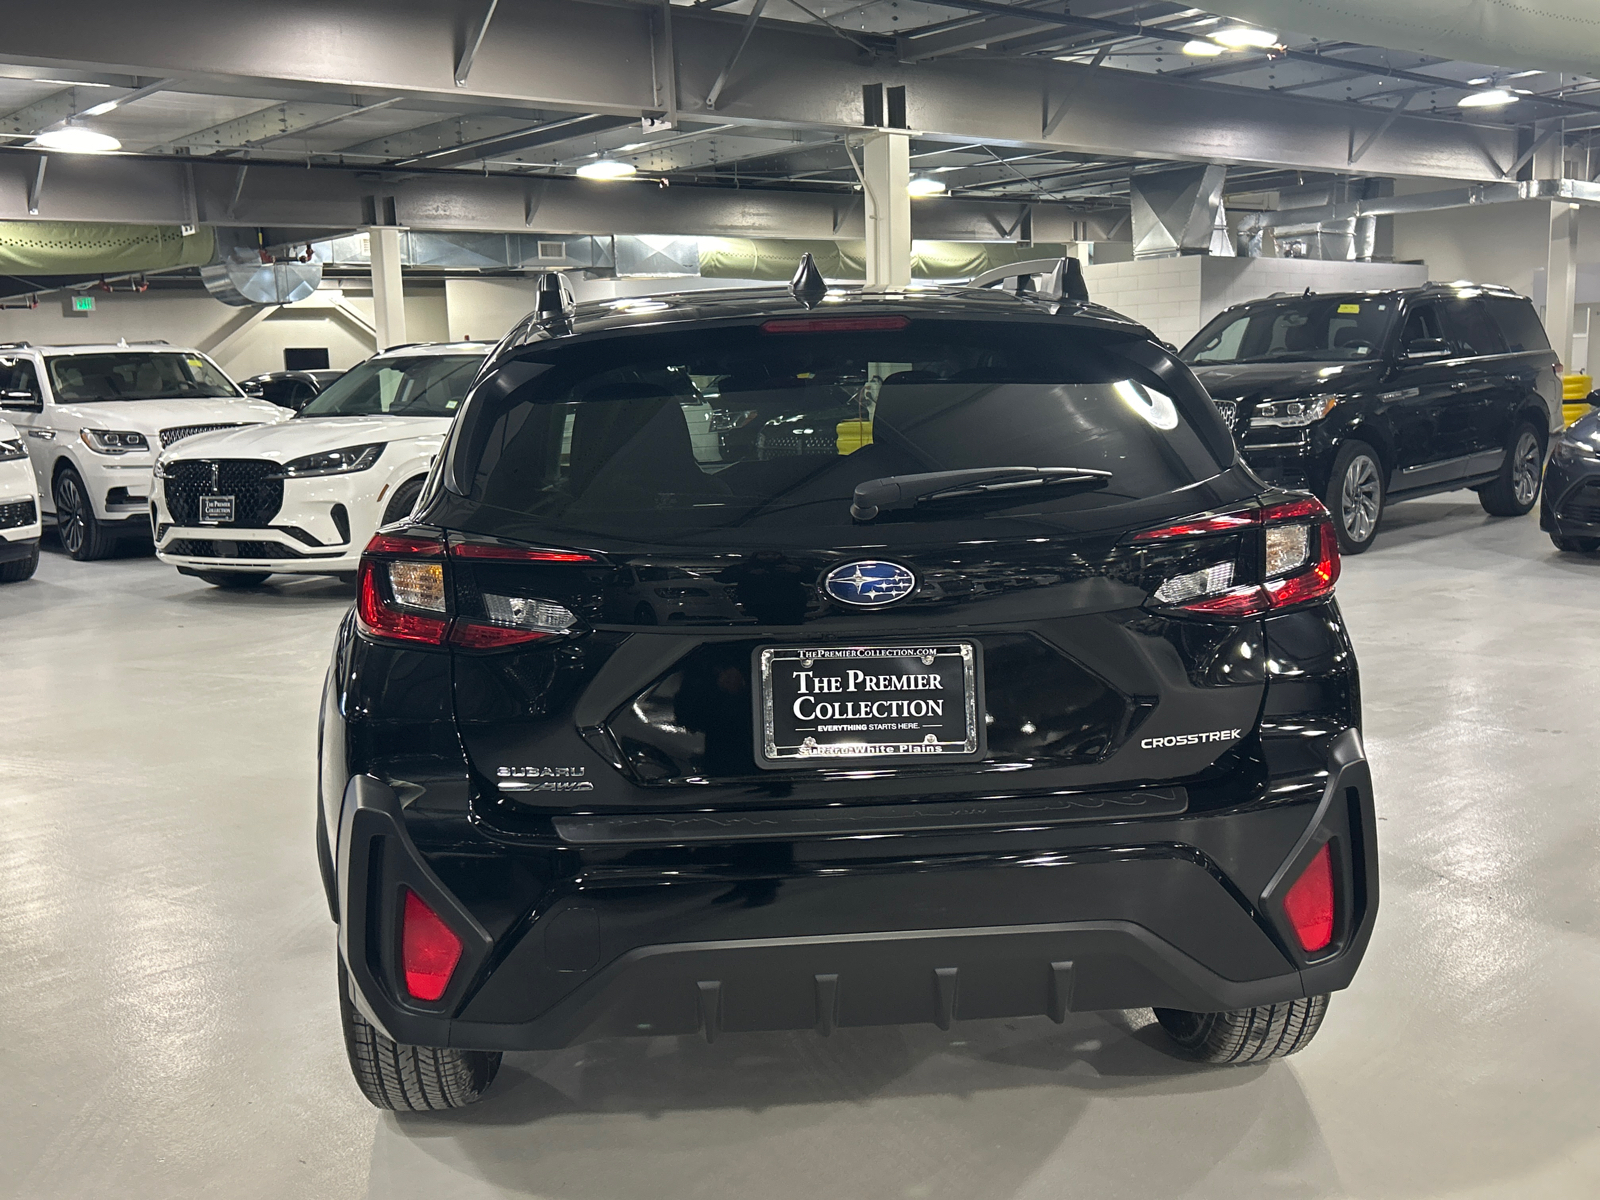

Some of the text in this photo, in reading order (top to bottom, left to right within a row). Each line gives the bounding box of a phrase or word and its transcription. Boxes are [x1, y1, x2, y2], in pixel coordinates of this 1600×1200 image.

[792, 669, 944, 693] THE PREMIER
[792, 696, 944, 720] COLLECTION
[817, 724, 868, 732] EVERYTHING
[868, 723, 897, 731] STARTS
[1140, 728, 1242, 749] CROSSTREK
[899, 743, 943, 753] Plains
[496, 766, 585, 777] SUBARU
[533, 781, 595, 792] AWD
